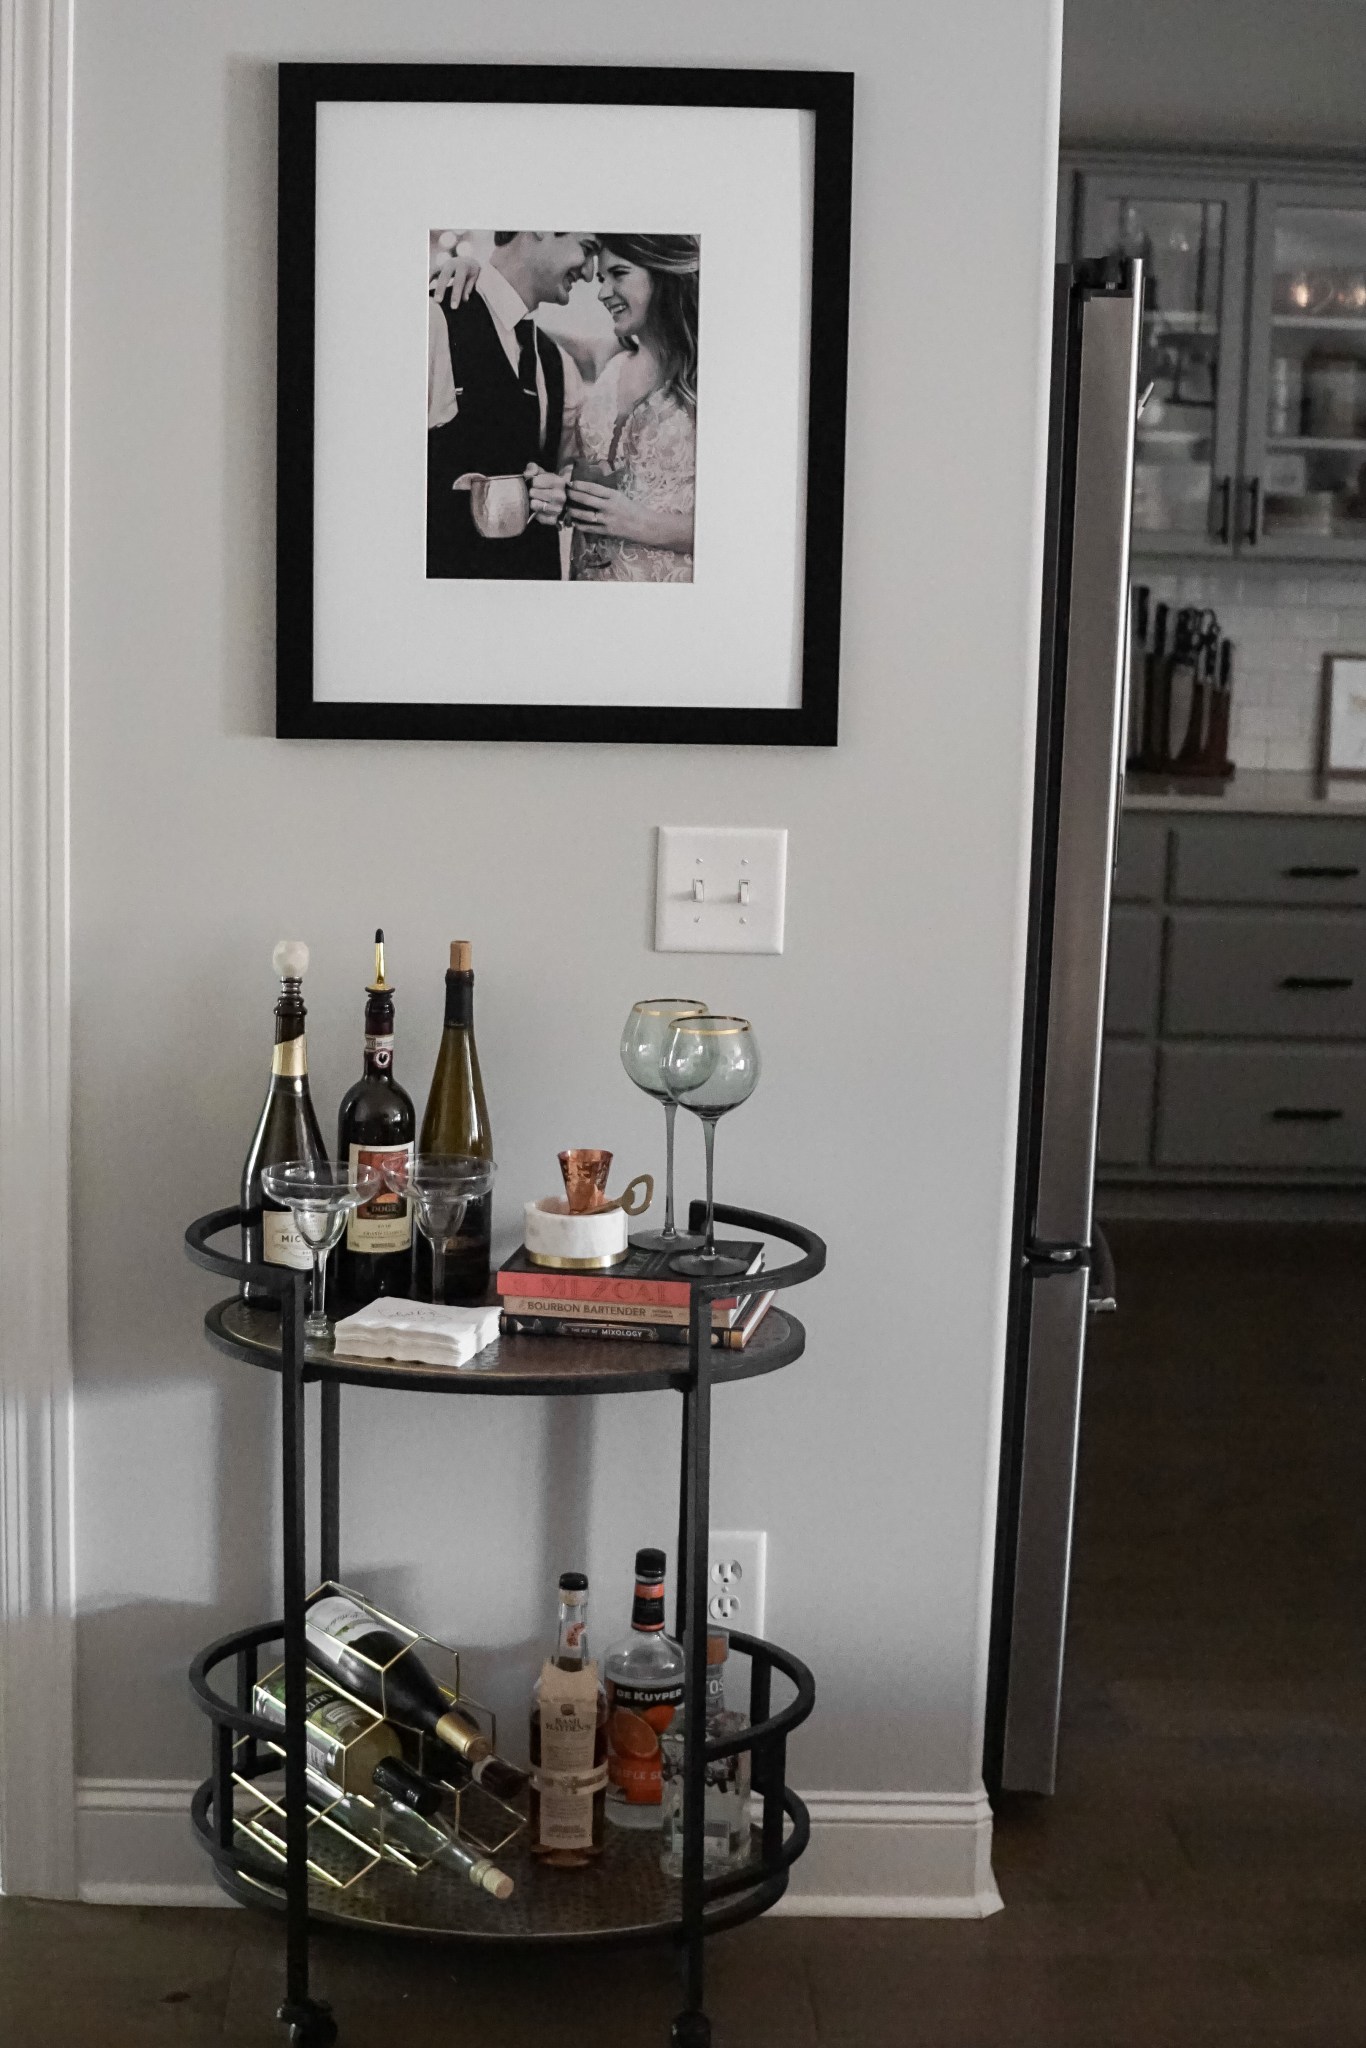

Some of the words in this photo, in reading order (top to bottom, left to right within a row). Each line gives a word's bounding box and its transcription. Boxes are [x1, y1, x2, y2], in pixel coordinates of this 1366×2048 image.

[281, 1234, 302, 1243] MIC
[527, 1301, 581, 1313] BOURBON
[583, 1304, 647, 1317] BARTENDER
[601, 1329, 643, 1338] MIXOLOGY
[633, 1688, 682, 1701] KUYPER
